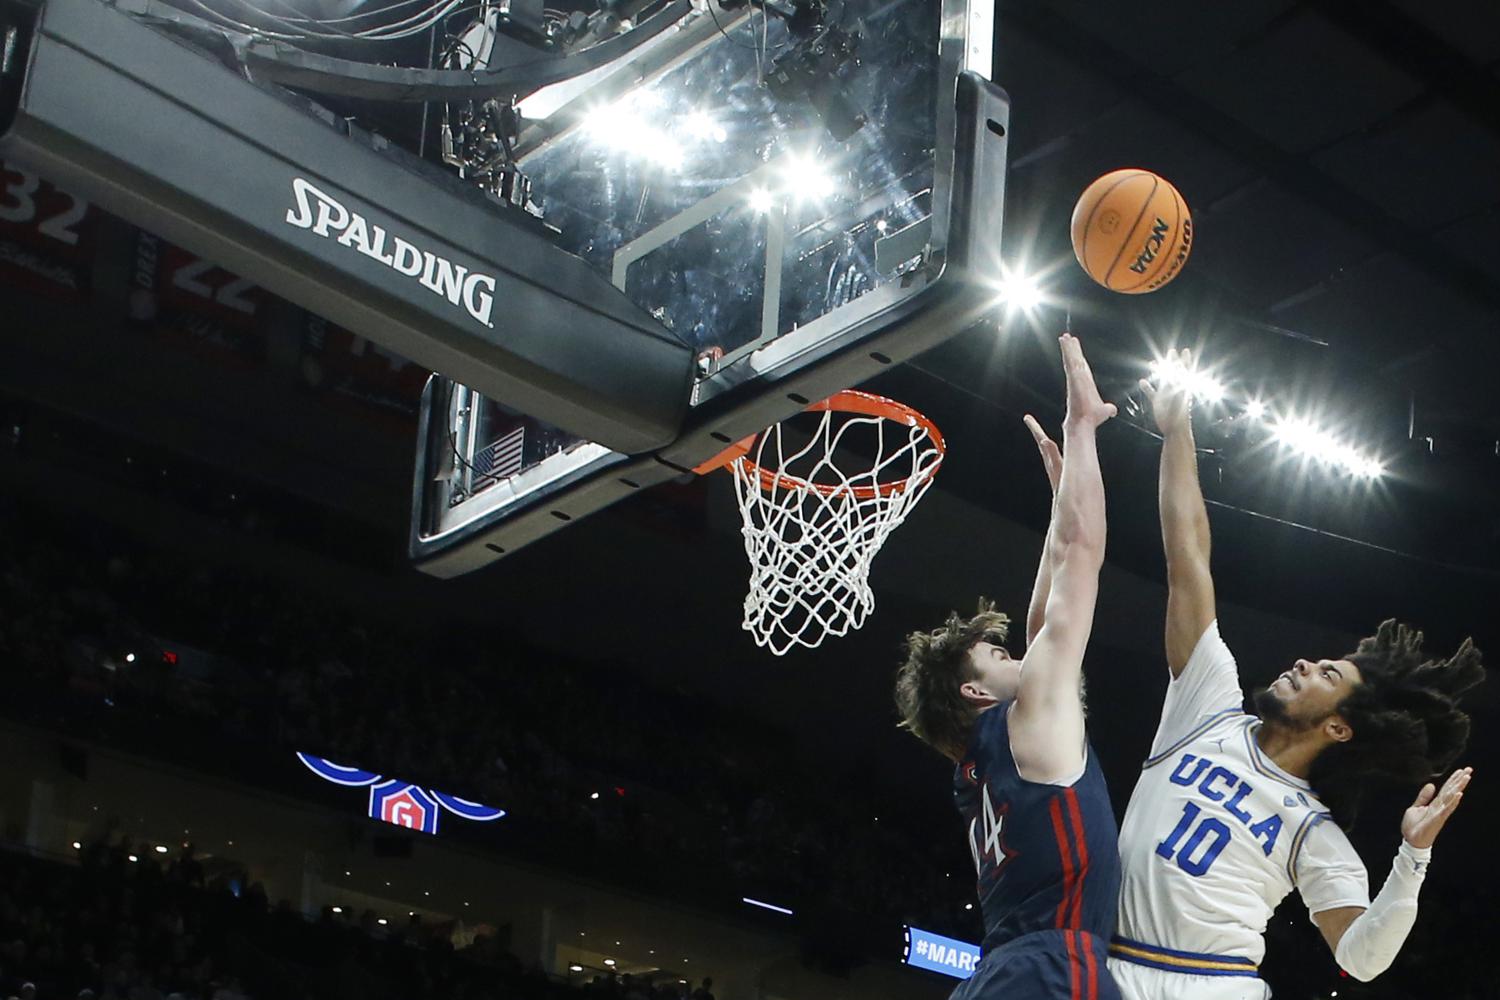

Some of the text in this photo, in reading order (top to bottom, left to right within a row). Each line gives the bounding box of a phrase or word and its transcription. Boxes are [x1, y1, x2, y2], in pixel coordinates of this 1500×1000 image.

[286, 178, 496, 327] SPALDING
[1128, 216, 1169, 274] NCAA
[1155, 801, 1232, 877] 10
[1169, 753, 1284, 857] UCLA
